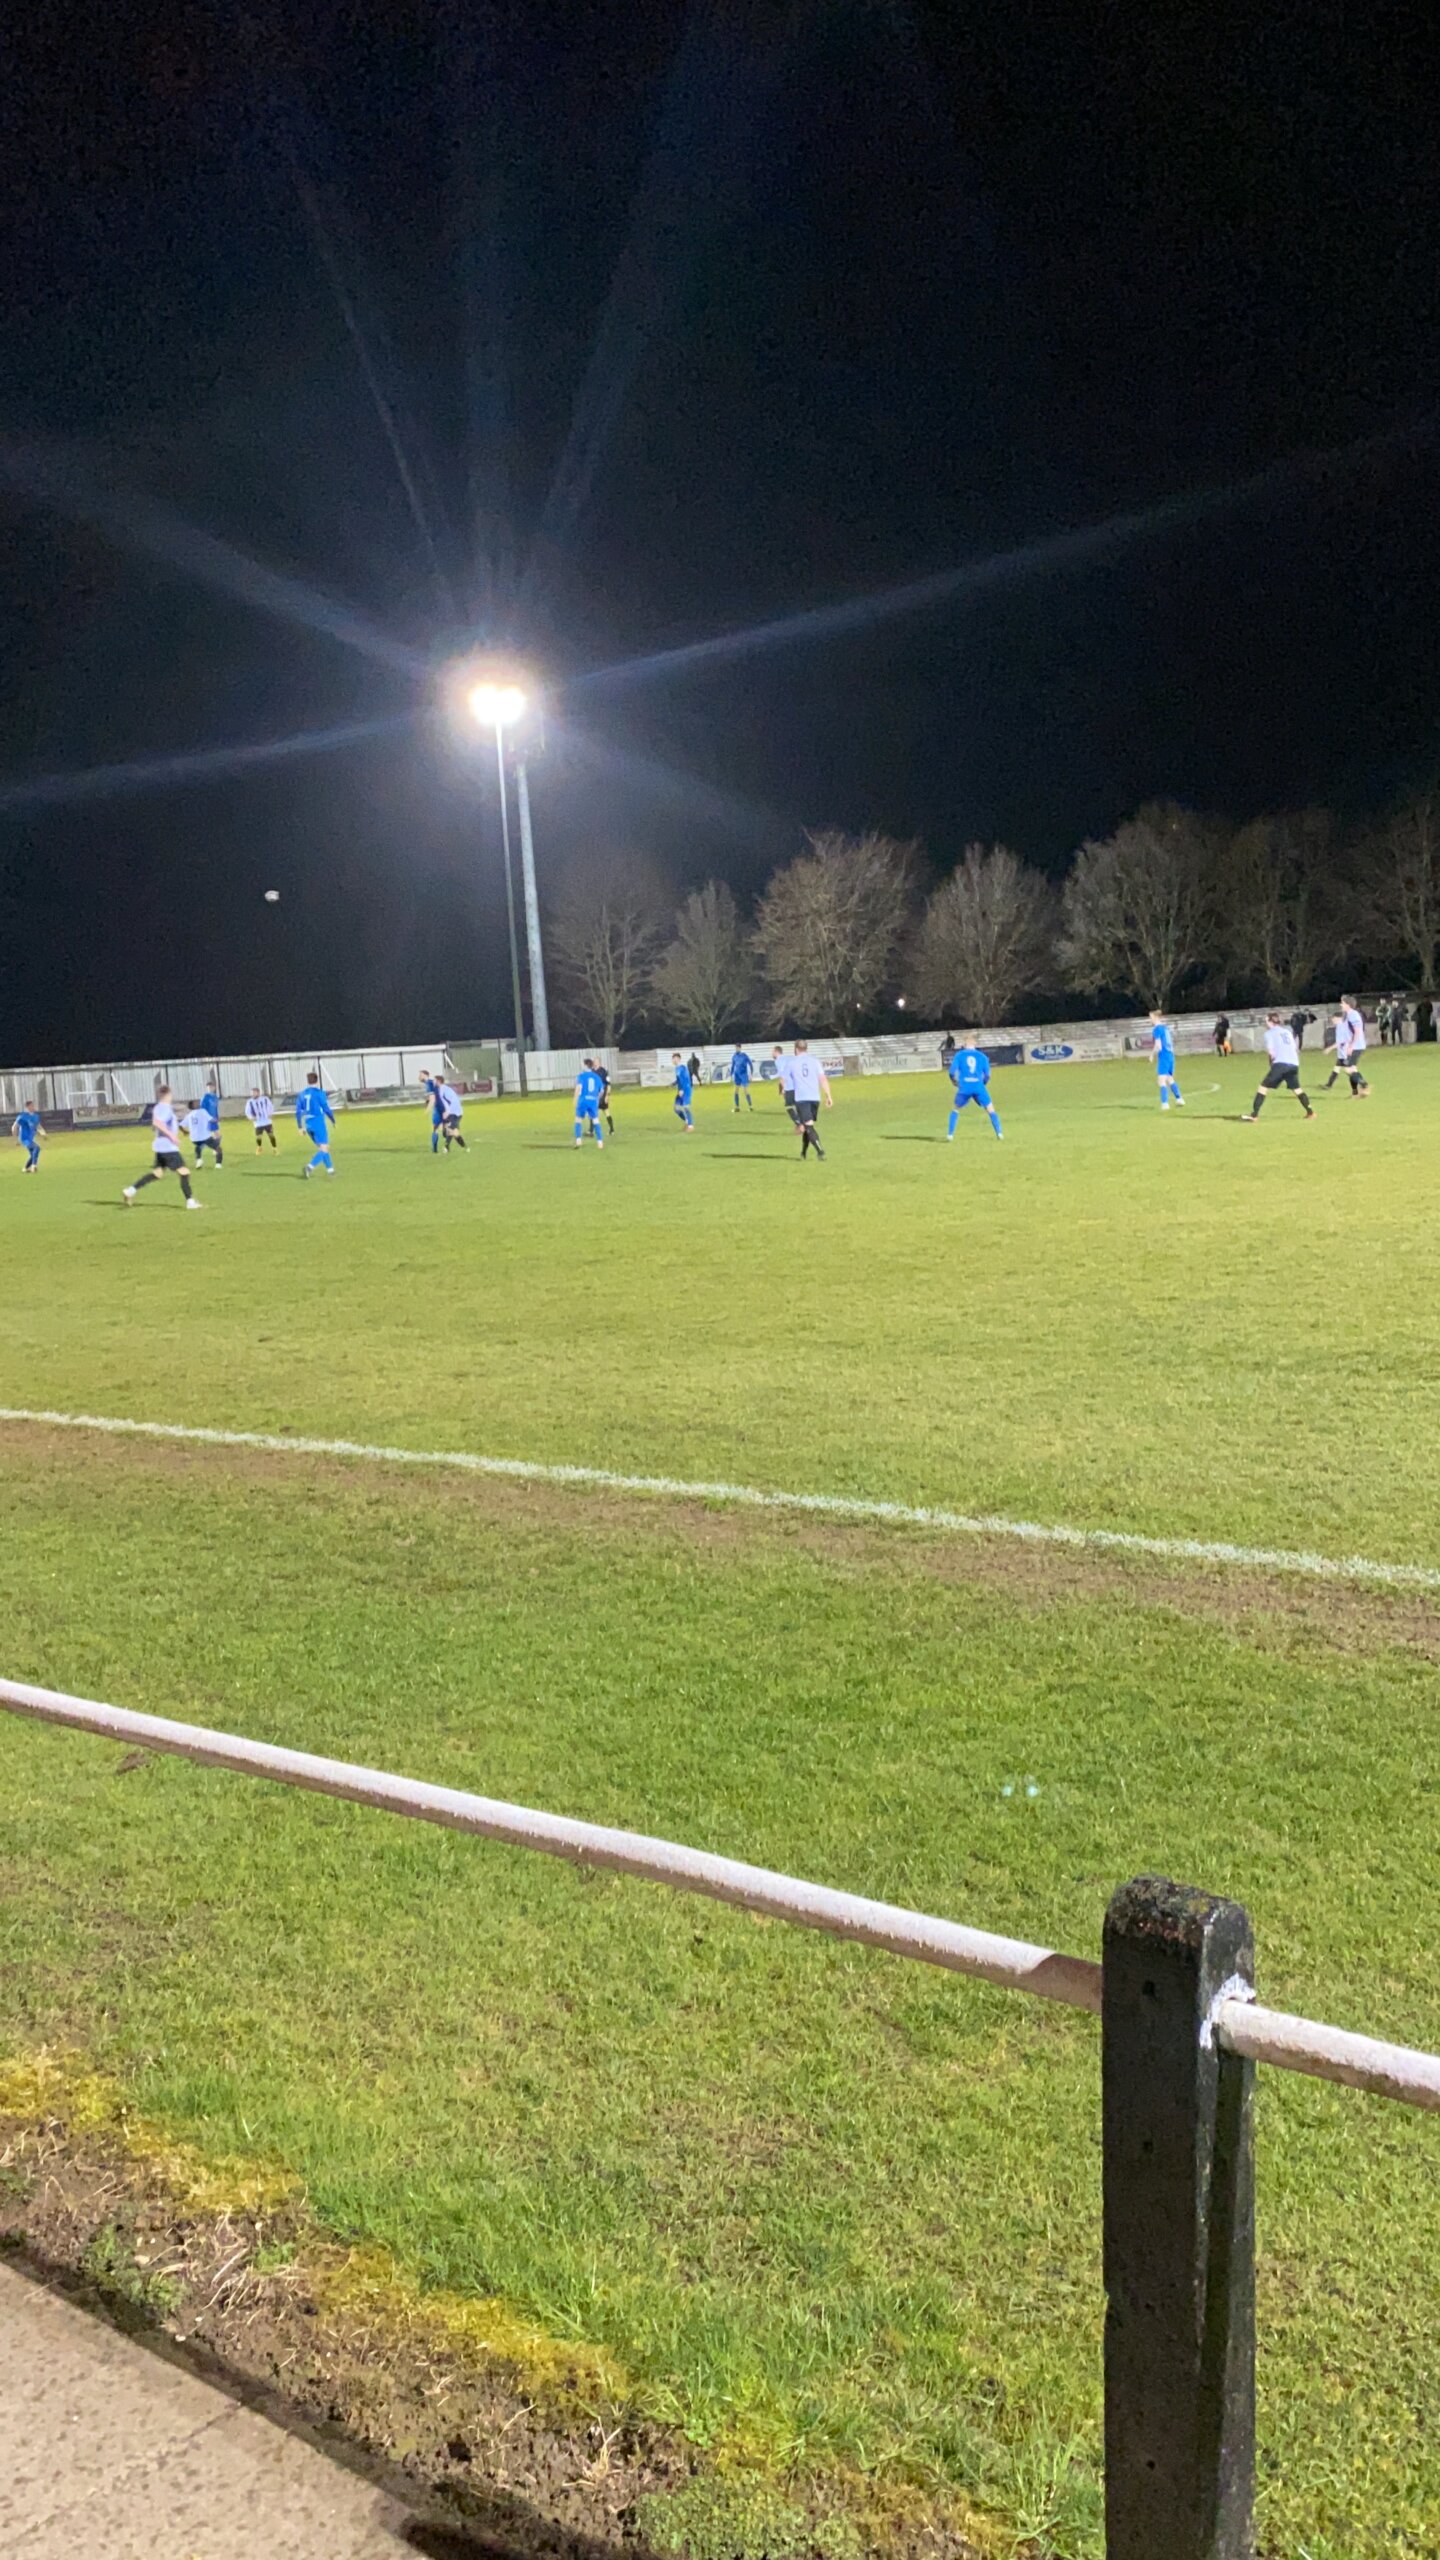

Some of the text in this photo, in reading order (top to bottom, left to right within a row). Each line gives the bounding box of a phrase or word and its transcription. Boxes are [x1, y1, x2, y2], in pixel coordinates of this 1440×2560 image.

[801, 1063, 809, 1078] 6
[966, 1055, 977, 1074] 9
[304, 1094, 312, 1112] 7
